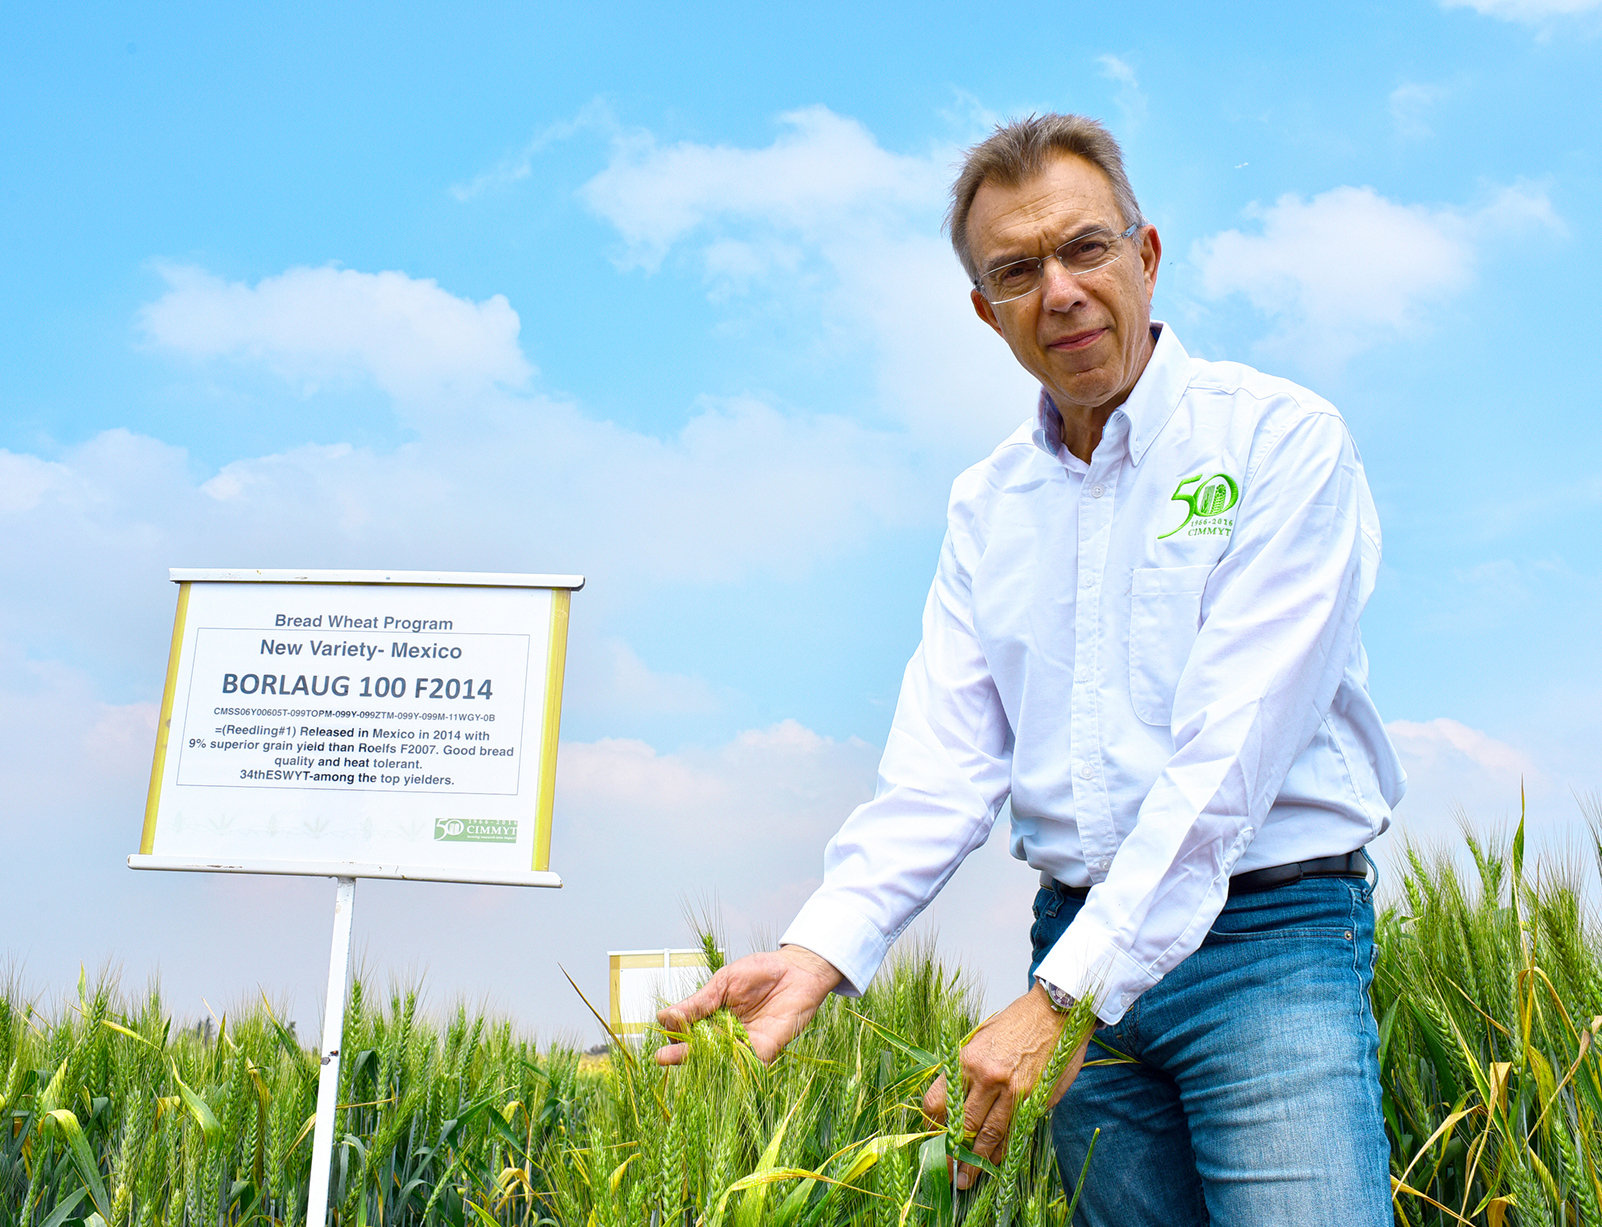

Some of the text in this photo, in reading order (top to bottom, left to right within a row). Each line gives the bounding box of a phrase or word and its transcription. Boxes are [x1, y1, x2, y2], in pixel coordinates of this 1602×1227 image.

[1190, 518, 1234, 527] 1966-2016
[1187, 526, 1232, 537] CIMMYT
[274, 613, 453, 634] Bread Wheat Program
[260, 638, 463, 661] New Variety- Mexico
[222, 673, 494, 701] BORLAUG 100 F2014
[214, 724, 490, 741] =(Reedling#1) Released in Mexico in 2014 with
[188, 738, 515, 757] 9% superior grain yield than Roelfs F2007. Good bread
[274, 755, 423, 770] quality and heat tolerant.
[239, 769, 455, 787] 34thESWYT-among the top yielders.
[466, 825, 517, 835] CIMMYT
